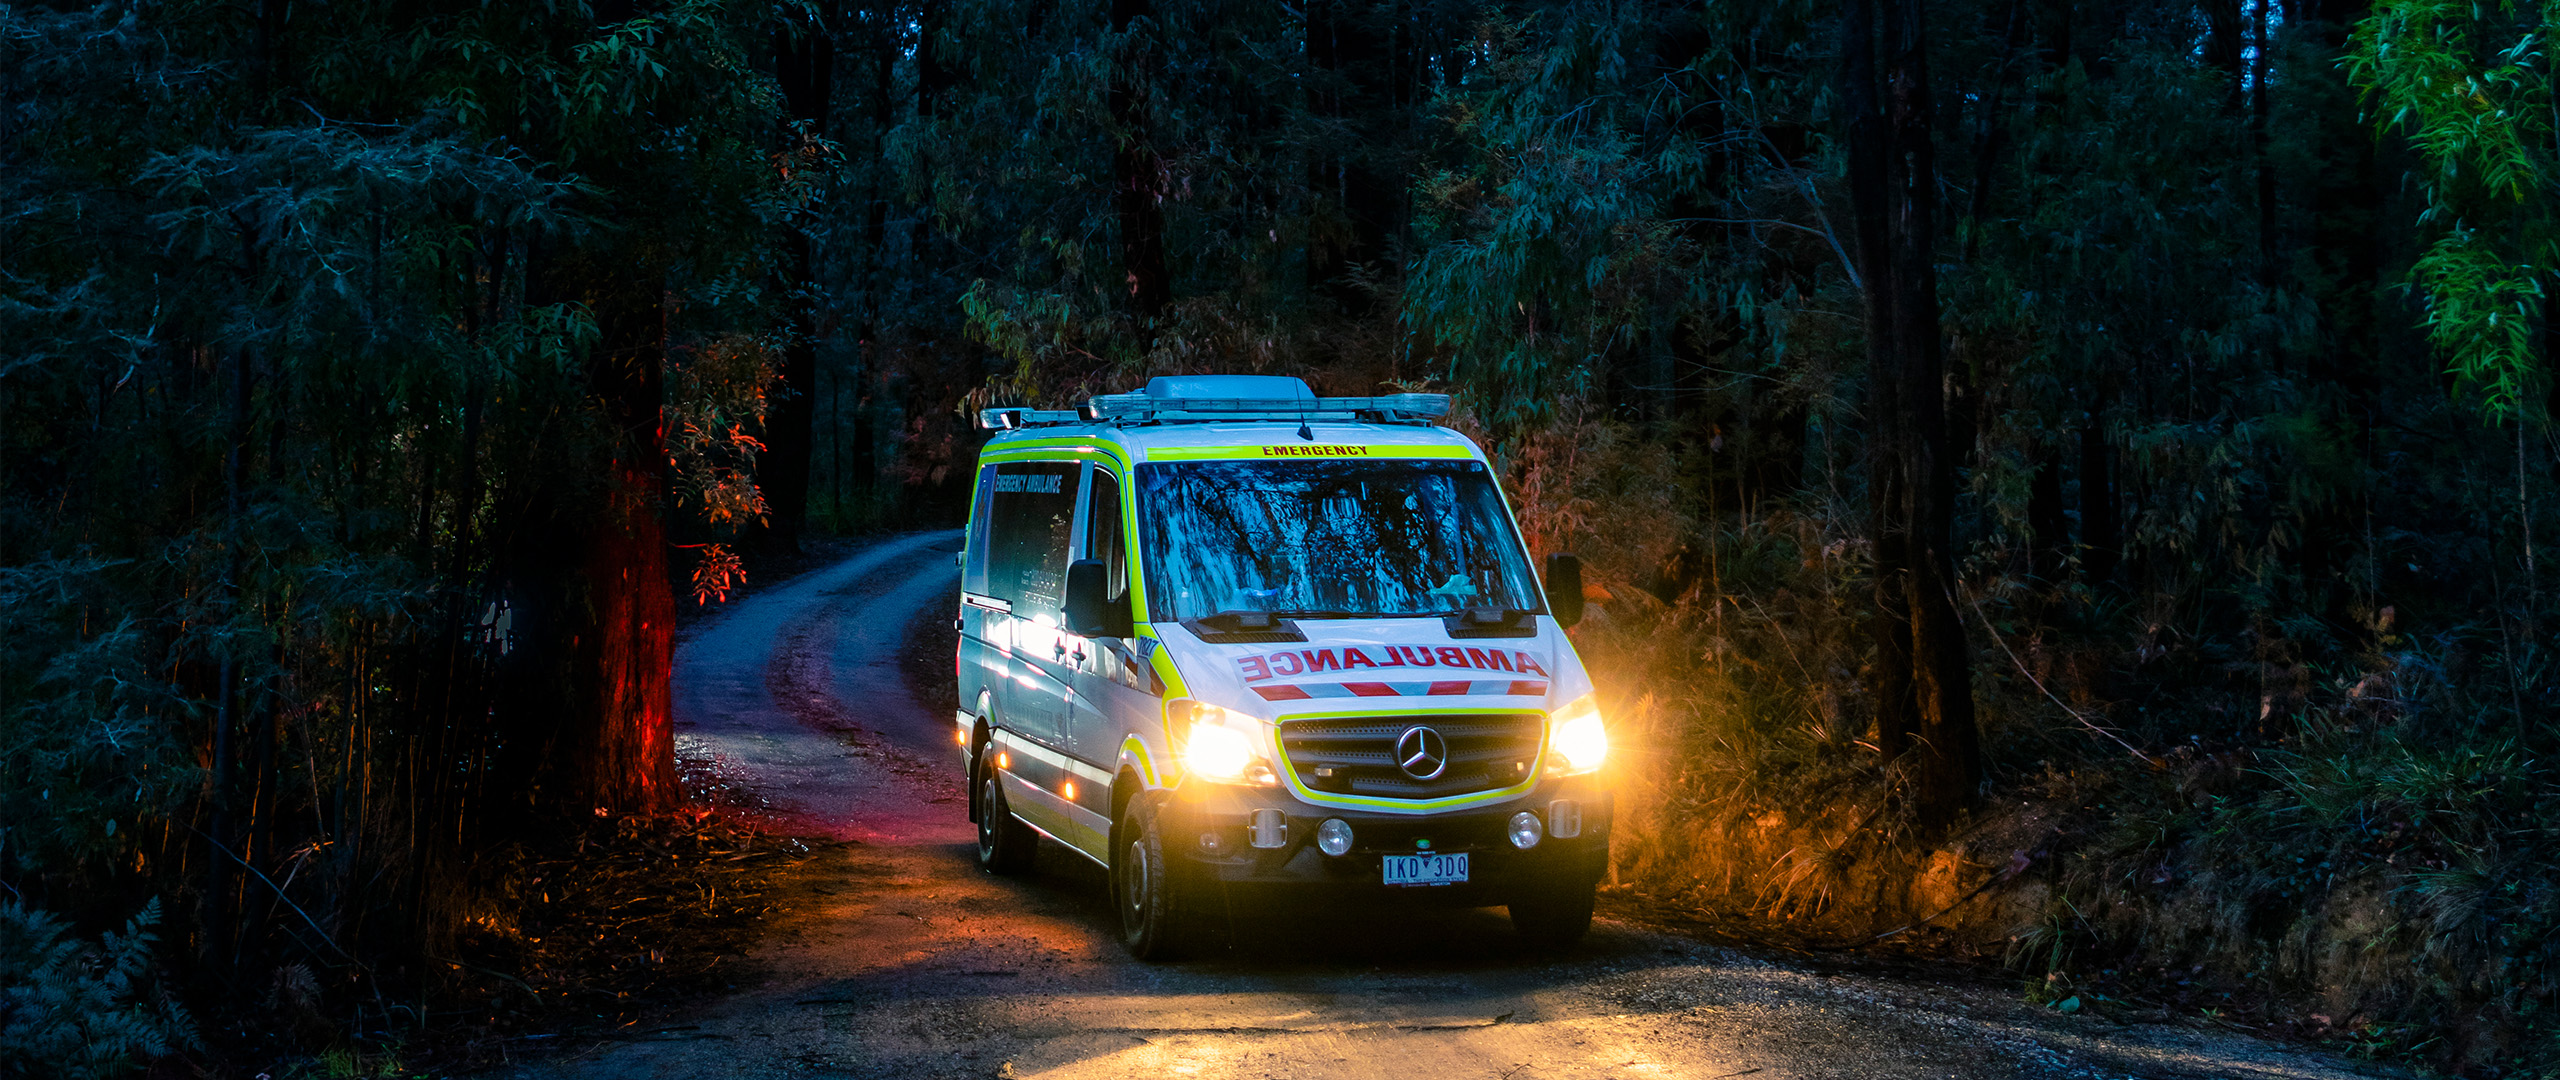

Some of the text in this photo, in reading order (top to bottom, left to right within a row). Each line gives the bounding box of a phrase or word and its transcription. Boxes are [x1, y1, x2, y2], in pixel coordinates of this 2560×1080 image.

[1262, 446, 1368, 456] EMERGENCY
[995, 474, 1063, 494] EMERGENCY AMBULANCE
[1387, 855, 1467, 879] 1KD 3DQ
